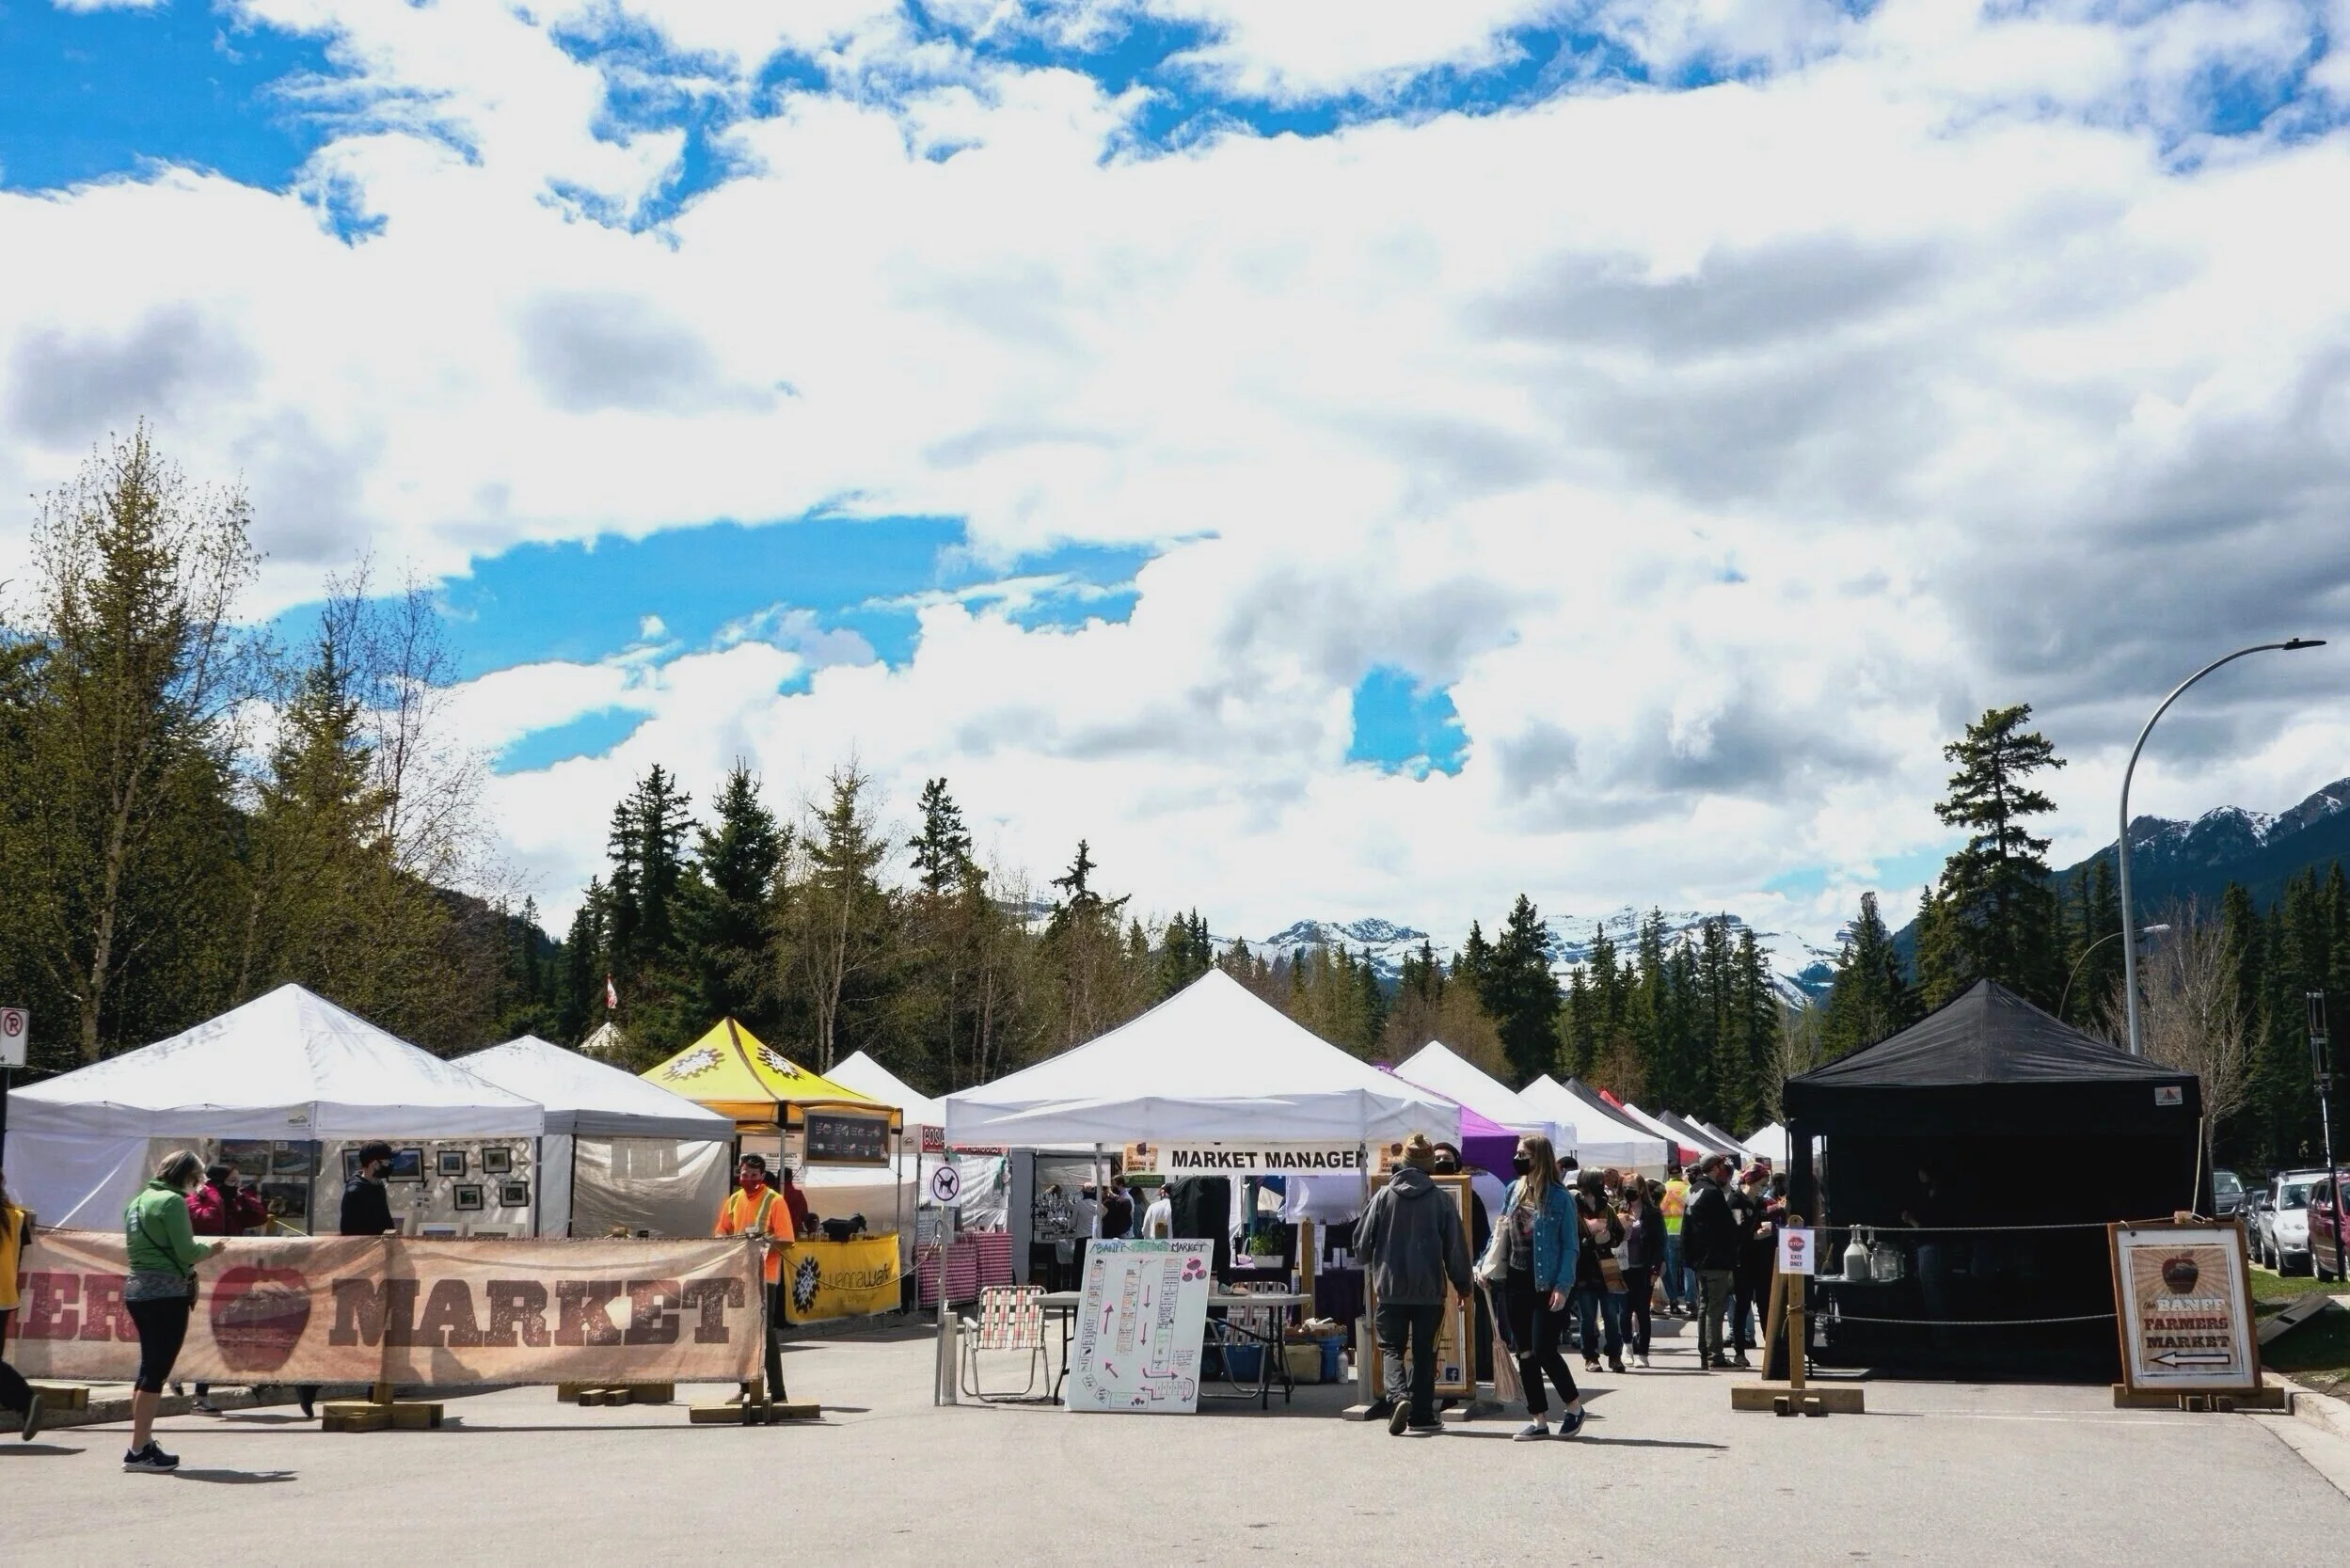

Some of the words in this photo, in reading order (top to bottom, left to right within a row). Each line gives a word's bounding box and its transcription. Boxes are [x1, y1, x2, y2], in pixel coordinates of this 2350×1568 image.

[1171, 1150, 1258, 1168] MARKET
[1265, 1151, 1369, 1168] MANAGER
[1171, 1241, 1206, 1252] MARKET
[327, 1276, 746, 1348] MARKET
[2144, 1301, 2156, 1310] the
[2156, 1298, 2226, 1312] BANFF
[2143, 1317, 2229, 1331] FARMERS
[2145, 1336, 2231, 1349] MARKET
